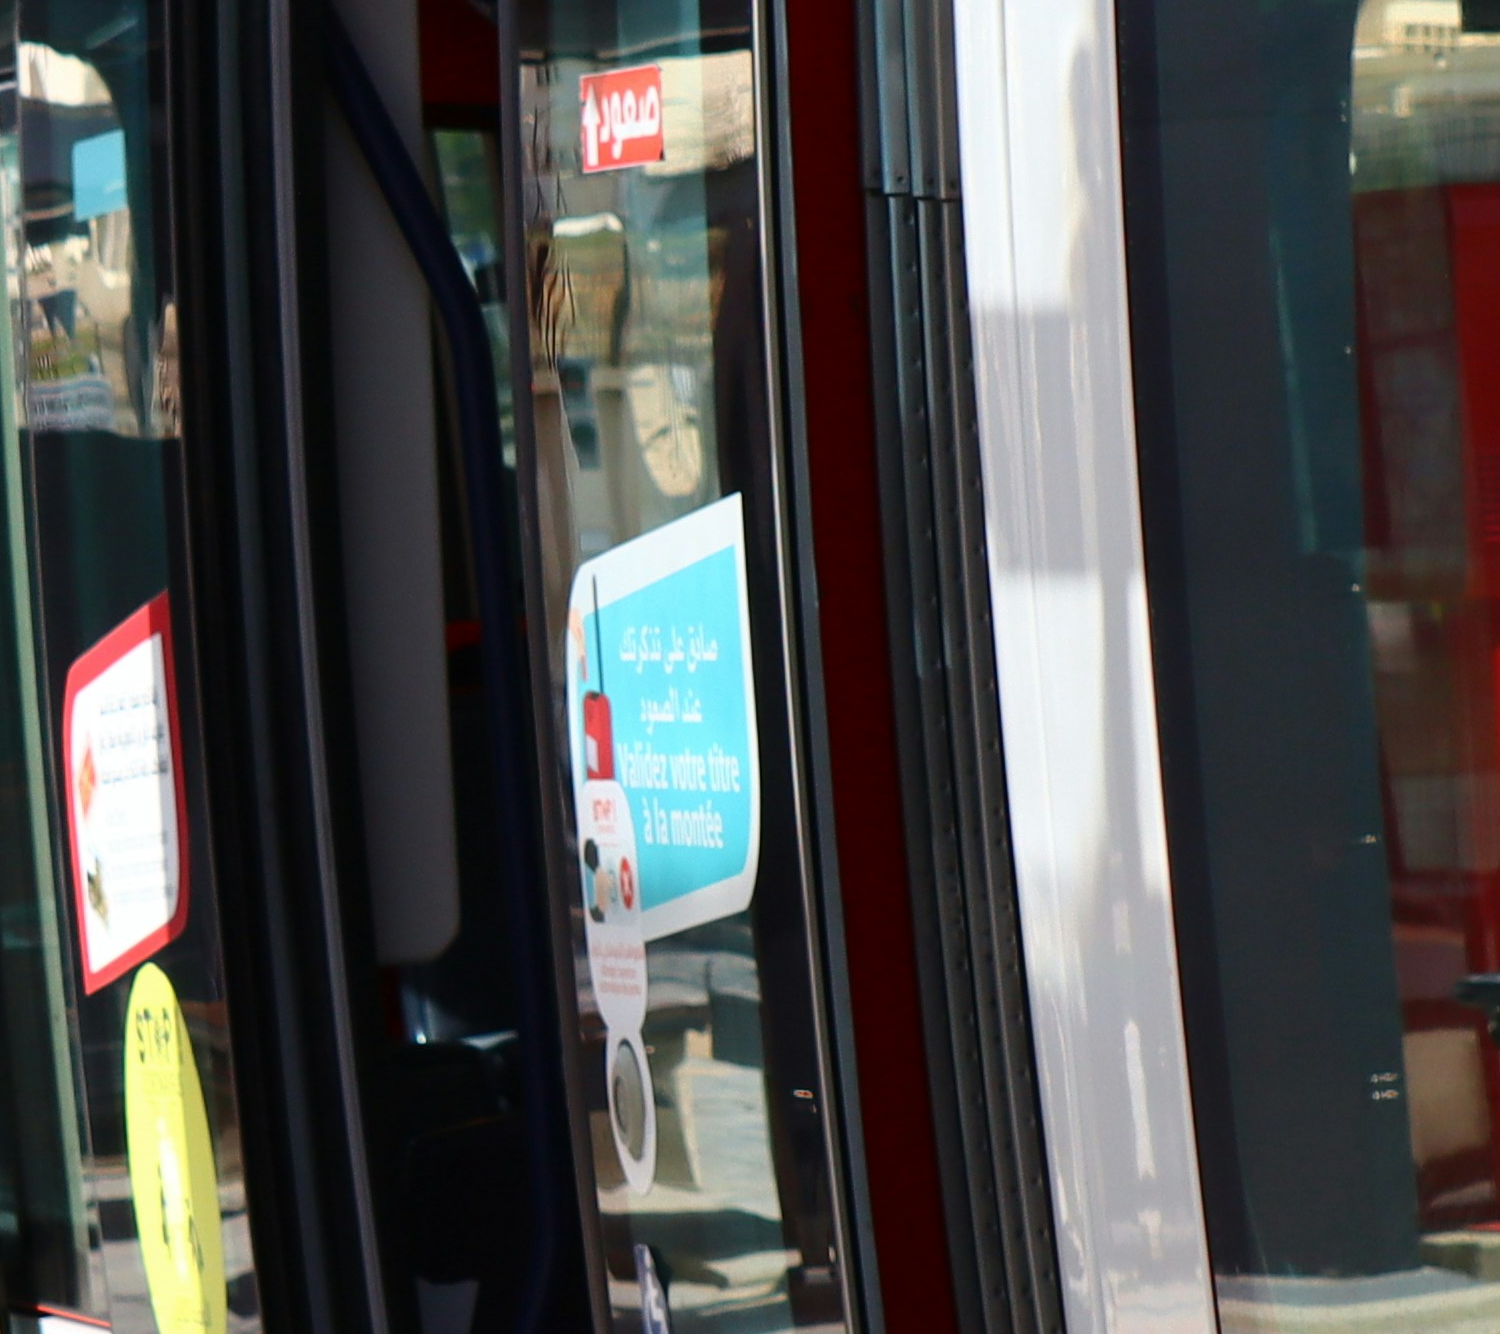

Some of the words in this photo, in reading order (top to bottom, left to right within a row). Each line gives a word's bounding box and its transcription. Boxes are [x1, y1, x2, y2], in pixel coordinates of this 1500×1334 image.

[600, 85, 661, 161] صعود
[616, 740, 669, 790] Validez
[669, 747, 707, 793] votre
[706, 741, 742, 794] titre
[652, 795, 669, 846] la
[670, 798, 725, 850] montée
